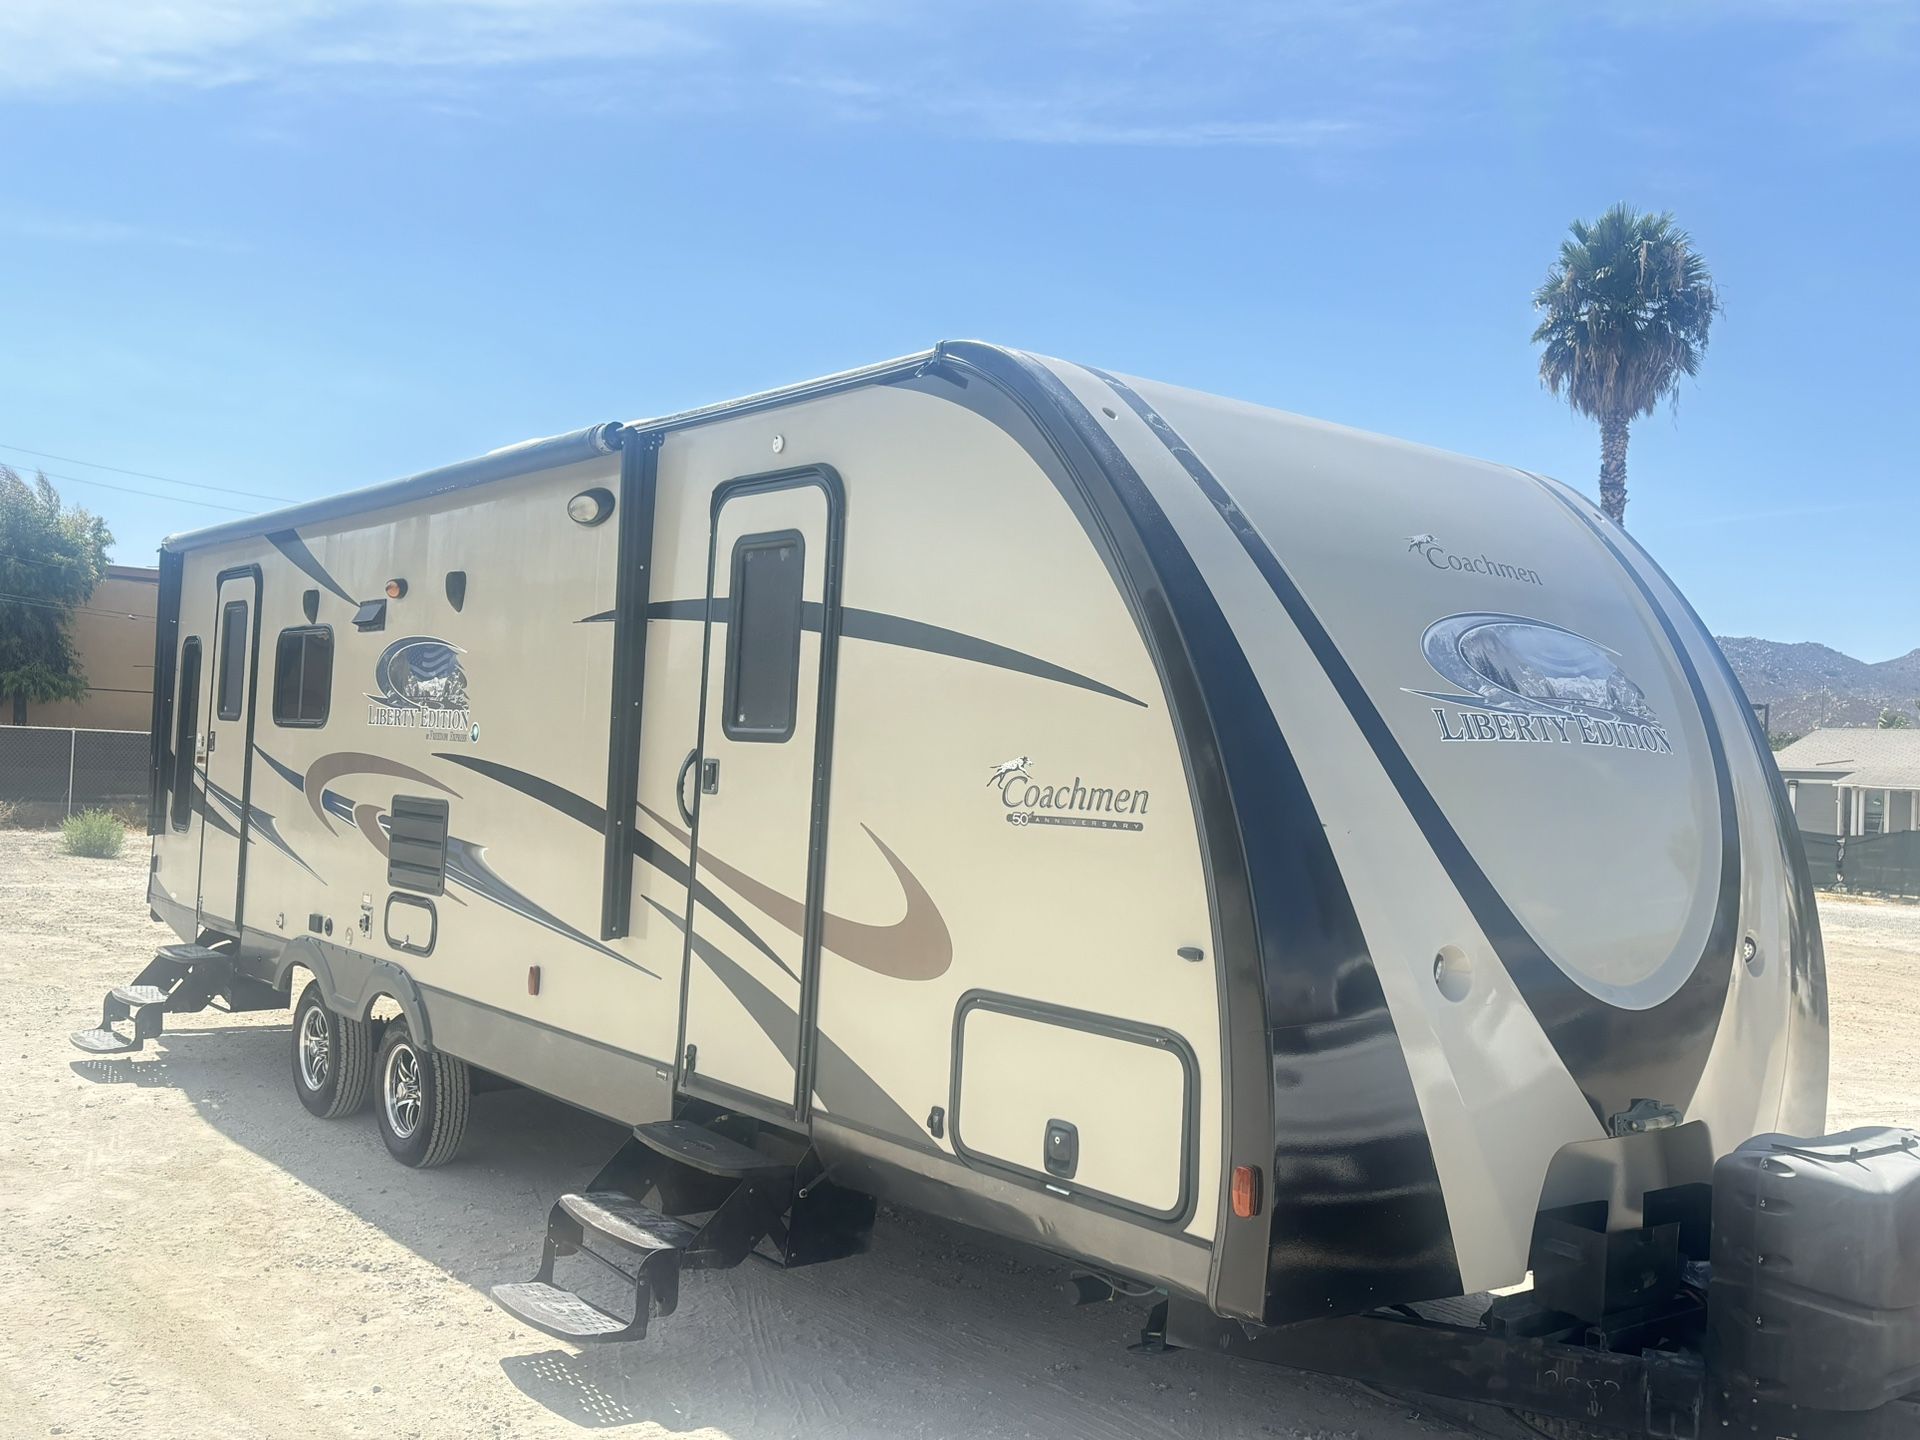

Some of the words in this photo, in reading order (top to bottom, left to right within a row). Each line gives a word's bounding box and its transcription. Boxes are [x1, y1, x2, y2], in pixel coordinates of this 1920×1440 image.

[1426, 546, 1543, 586] Coachmen
[368, 705, 418, 726] LIBERTY
[420, 706, 469, 729] EDITION
[1433, 709, 1568, 742] LIBERTY
[1575, 714, 1673, 754] EDITION
[1002, 776, 1149, 814] Coachmen
[1035, 817, 1140, 829] ANNVERSARY
